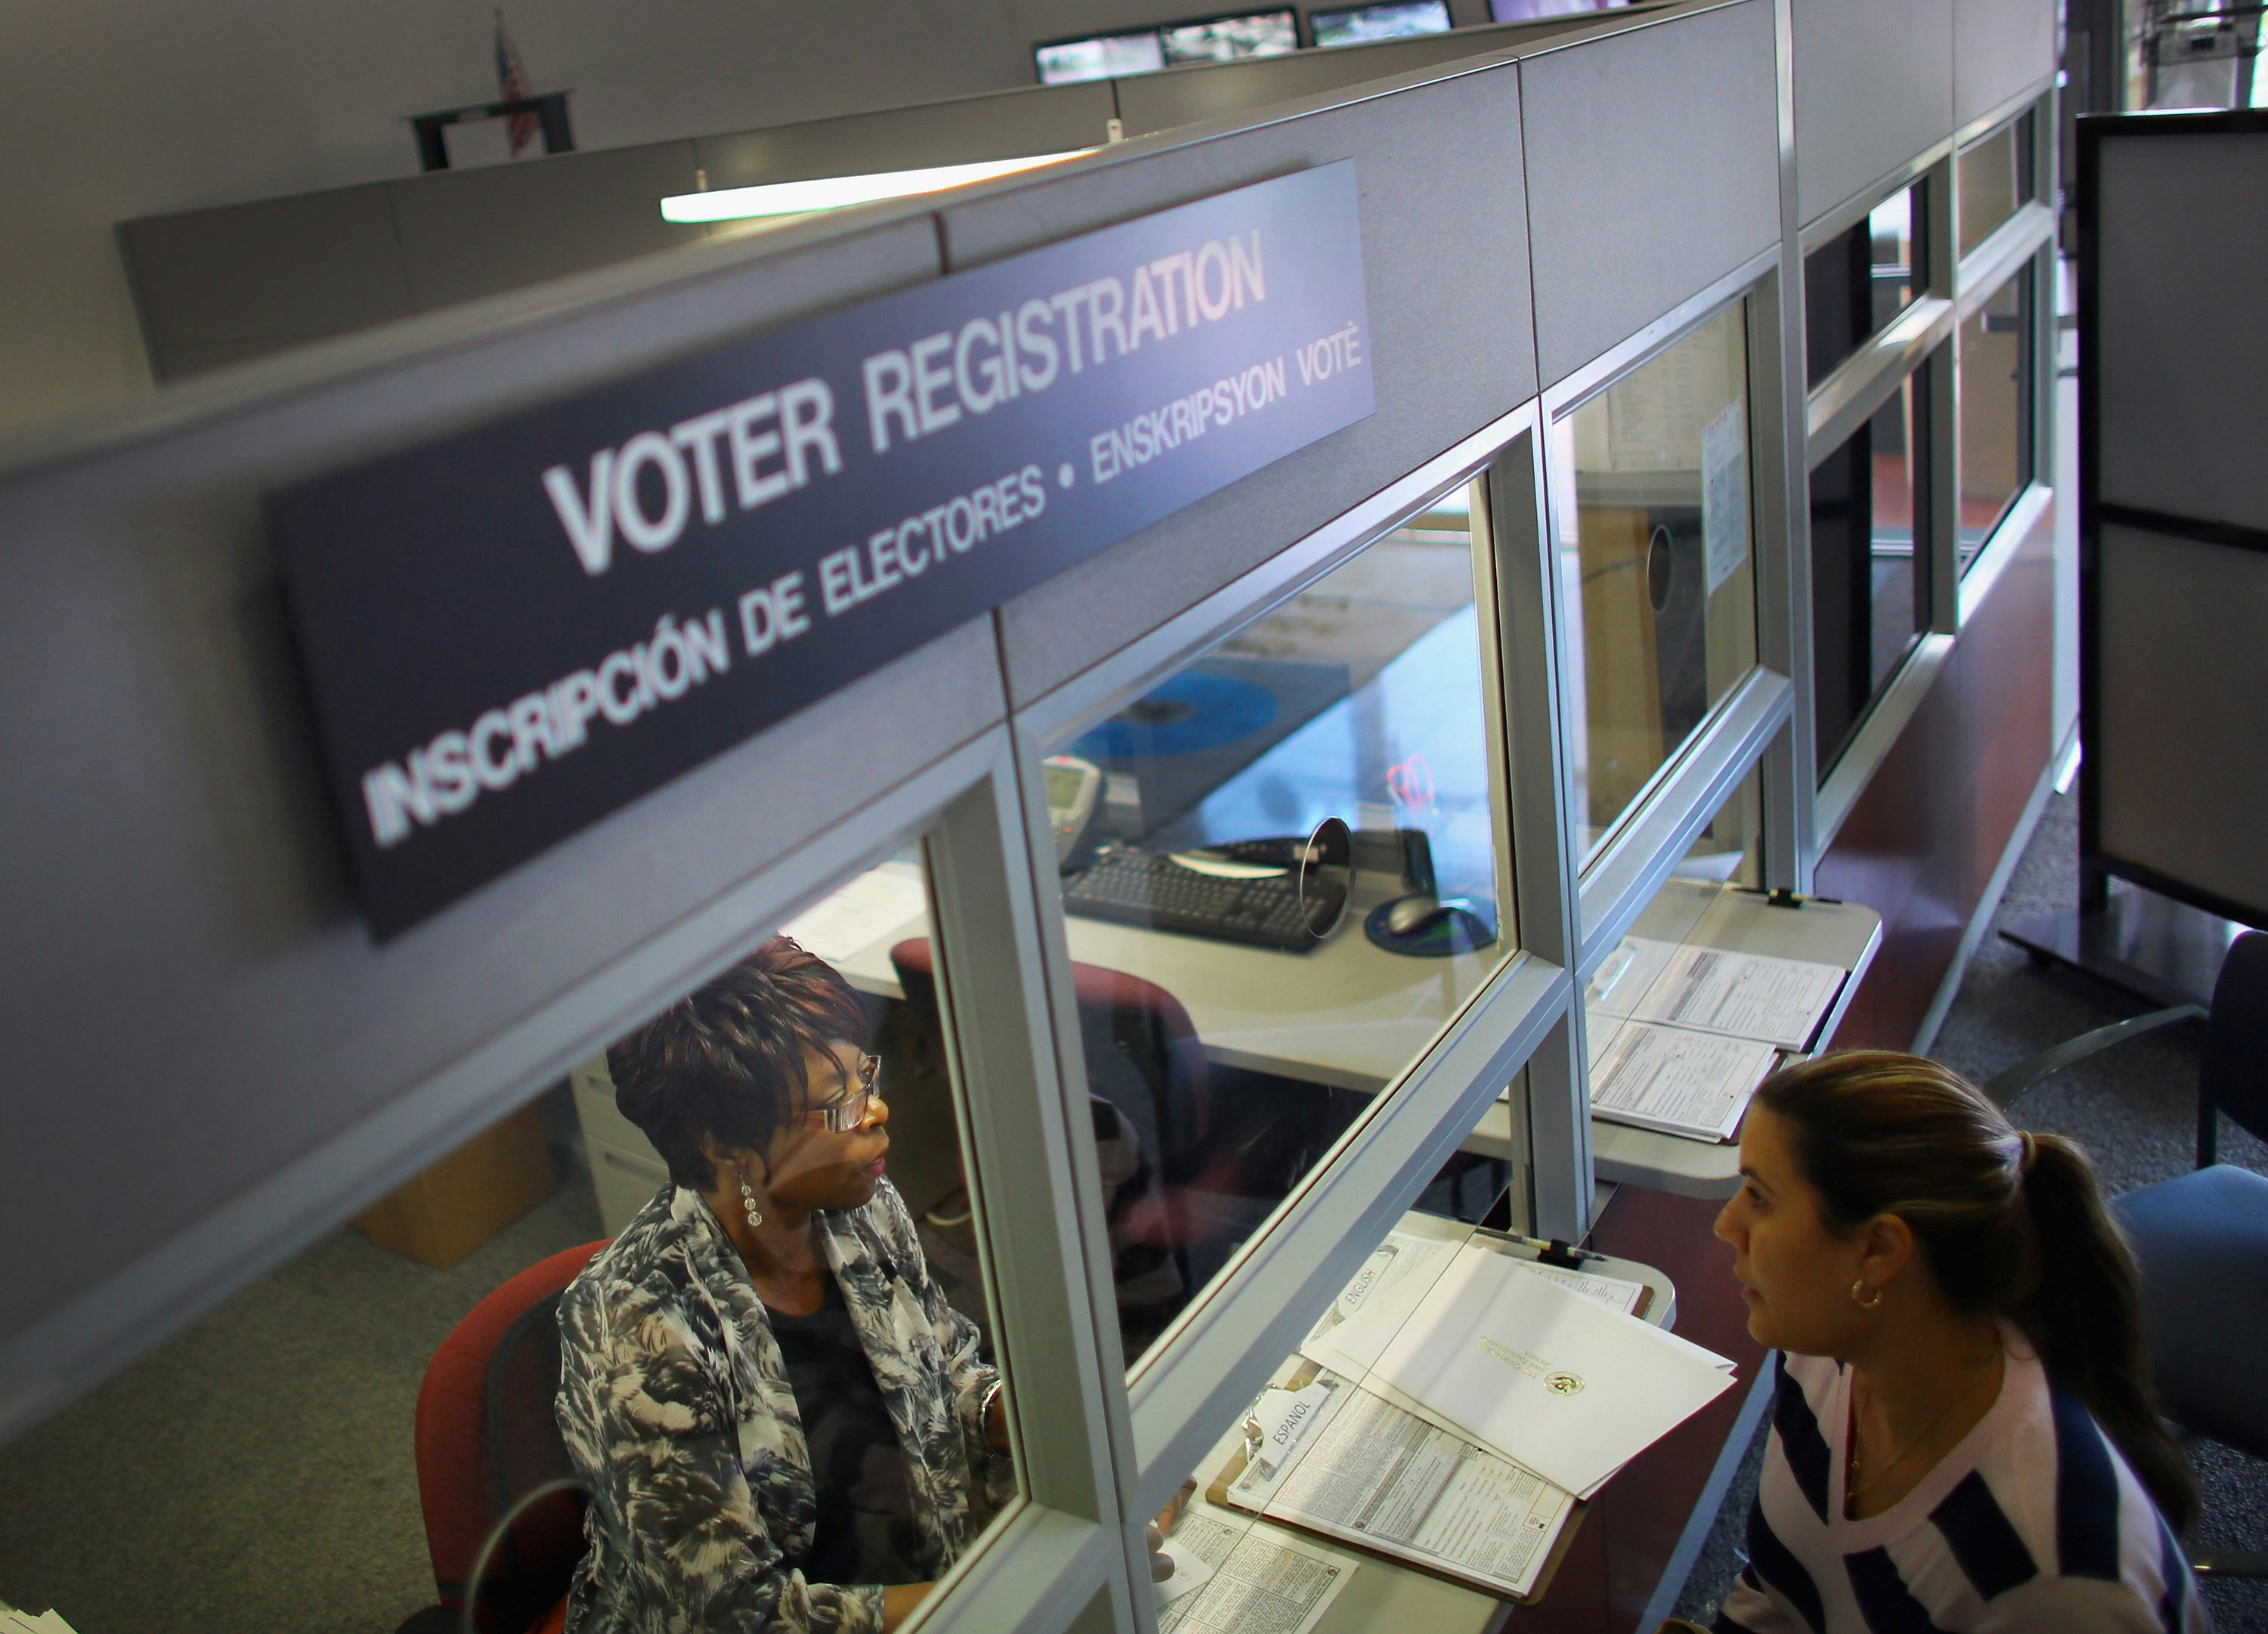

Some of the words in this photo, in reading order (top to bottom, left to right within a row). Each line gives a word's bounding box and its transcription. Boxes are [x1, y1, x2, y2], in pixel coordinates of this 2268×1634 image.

[543, 377, 841, 575] VOTER
[863, 229, 1267, 452] REGISTRATION
[362, 608, 730, 847] INSCRIPCIÓN
[739, 571, 811, 656] DE
[819, 464, 1046, 614] ELECTORES
[1089, 357, 1287, 484] ENSKRIPSYON
[1345, 1268, 1376, 1305] ENGLISH
[1272, 1401, 1311, 1445] ESPANOL
